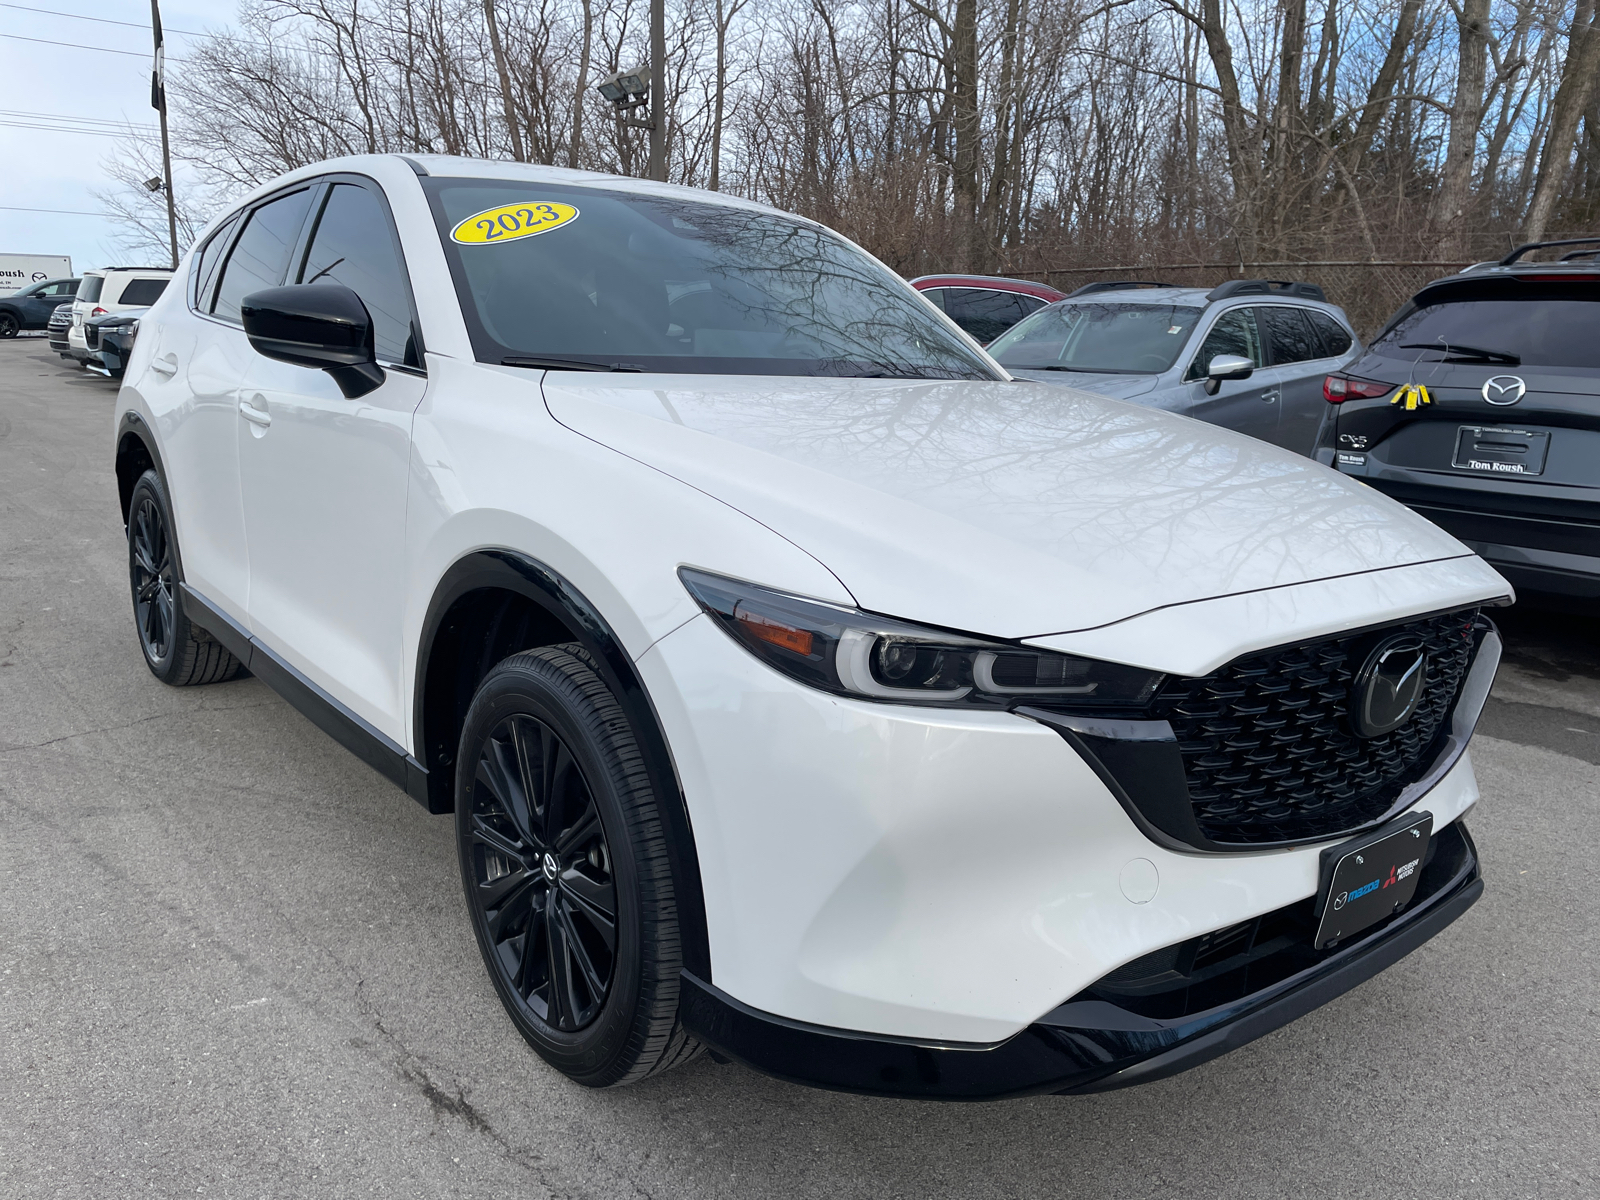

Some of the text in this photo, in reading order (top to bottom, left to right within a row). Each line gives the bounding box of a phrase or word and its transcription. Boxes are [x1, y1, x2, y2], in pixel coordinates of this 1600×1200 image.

[476, 204, 560, 240] 2023
[1340, 433, 1368, 444] CX-5
[1469, 460, 1524, 473] Tom Roush
